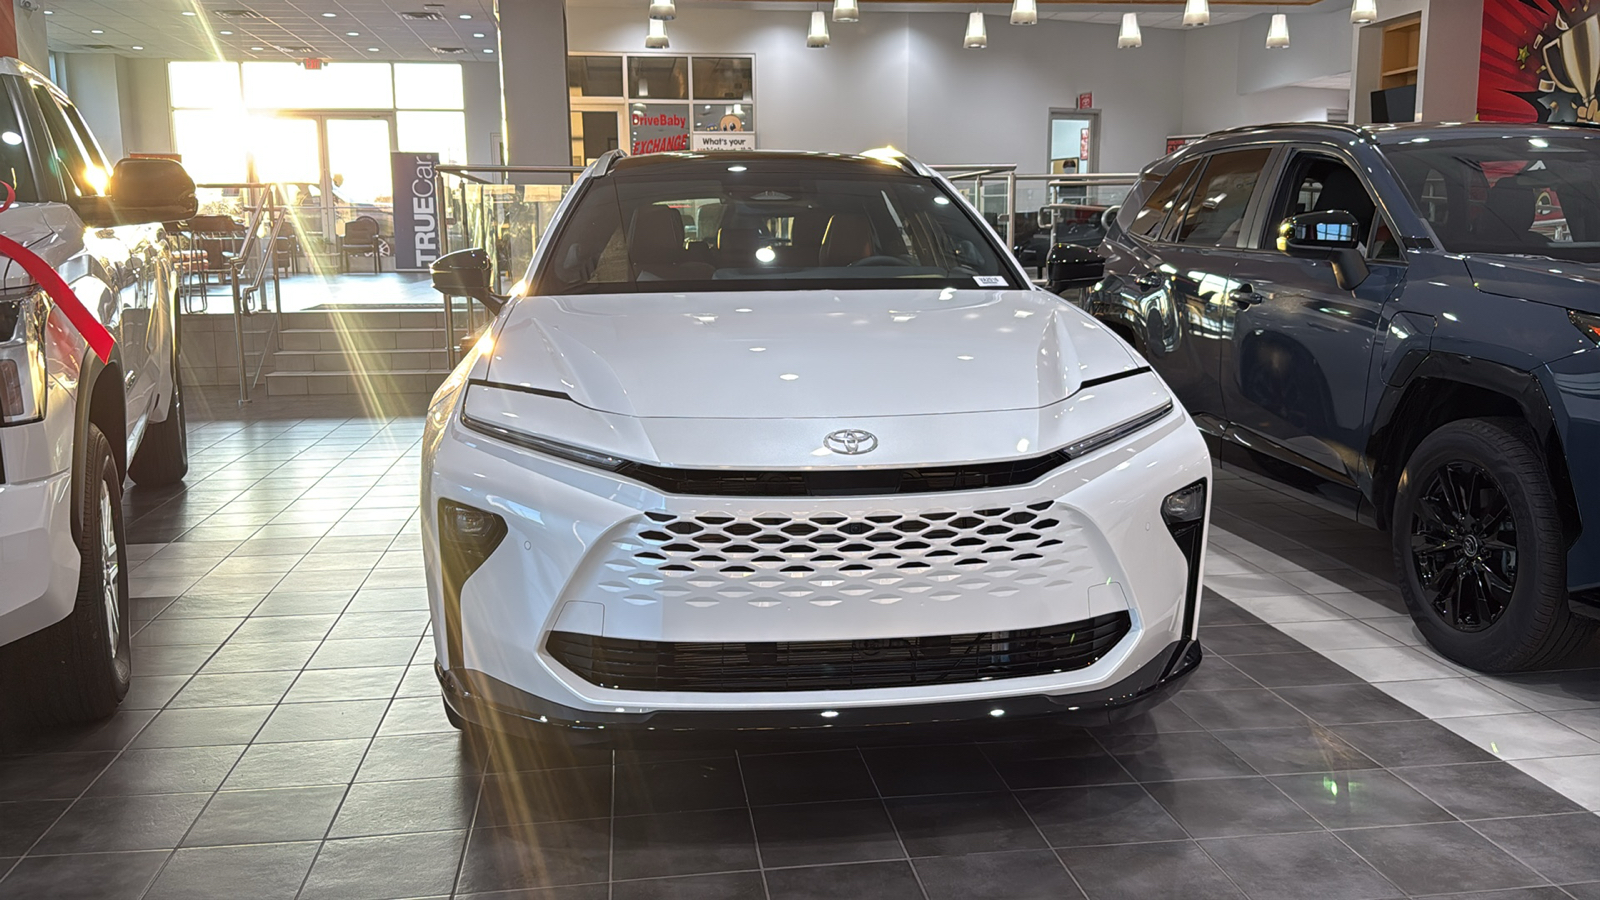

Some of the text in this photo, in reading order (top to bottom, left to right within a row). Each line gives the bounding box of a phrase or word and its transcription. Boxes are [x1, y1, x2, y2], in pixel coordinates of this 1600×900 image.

[306, 59, 320, 69] EXIT
[632, 113, 686, 128] DriveBaby
[633, 134, 688, 155] EXCHANGE
[702, 138, 727, 146] What's
